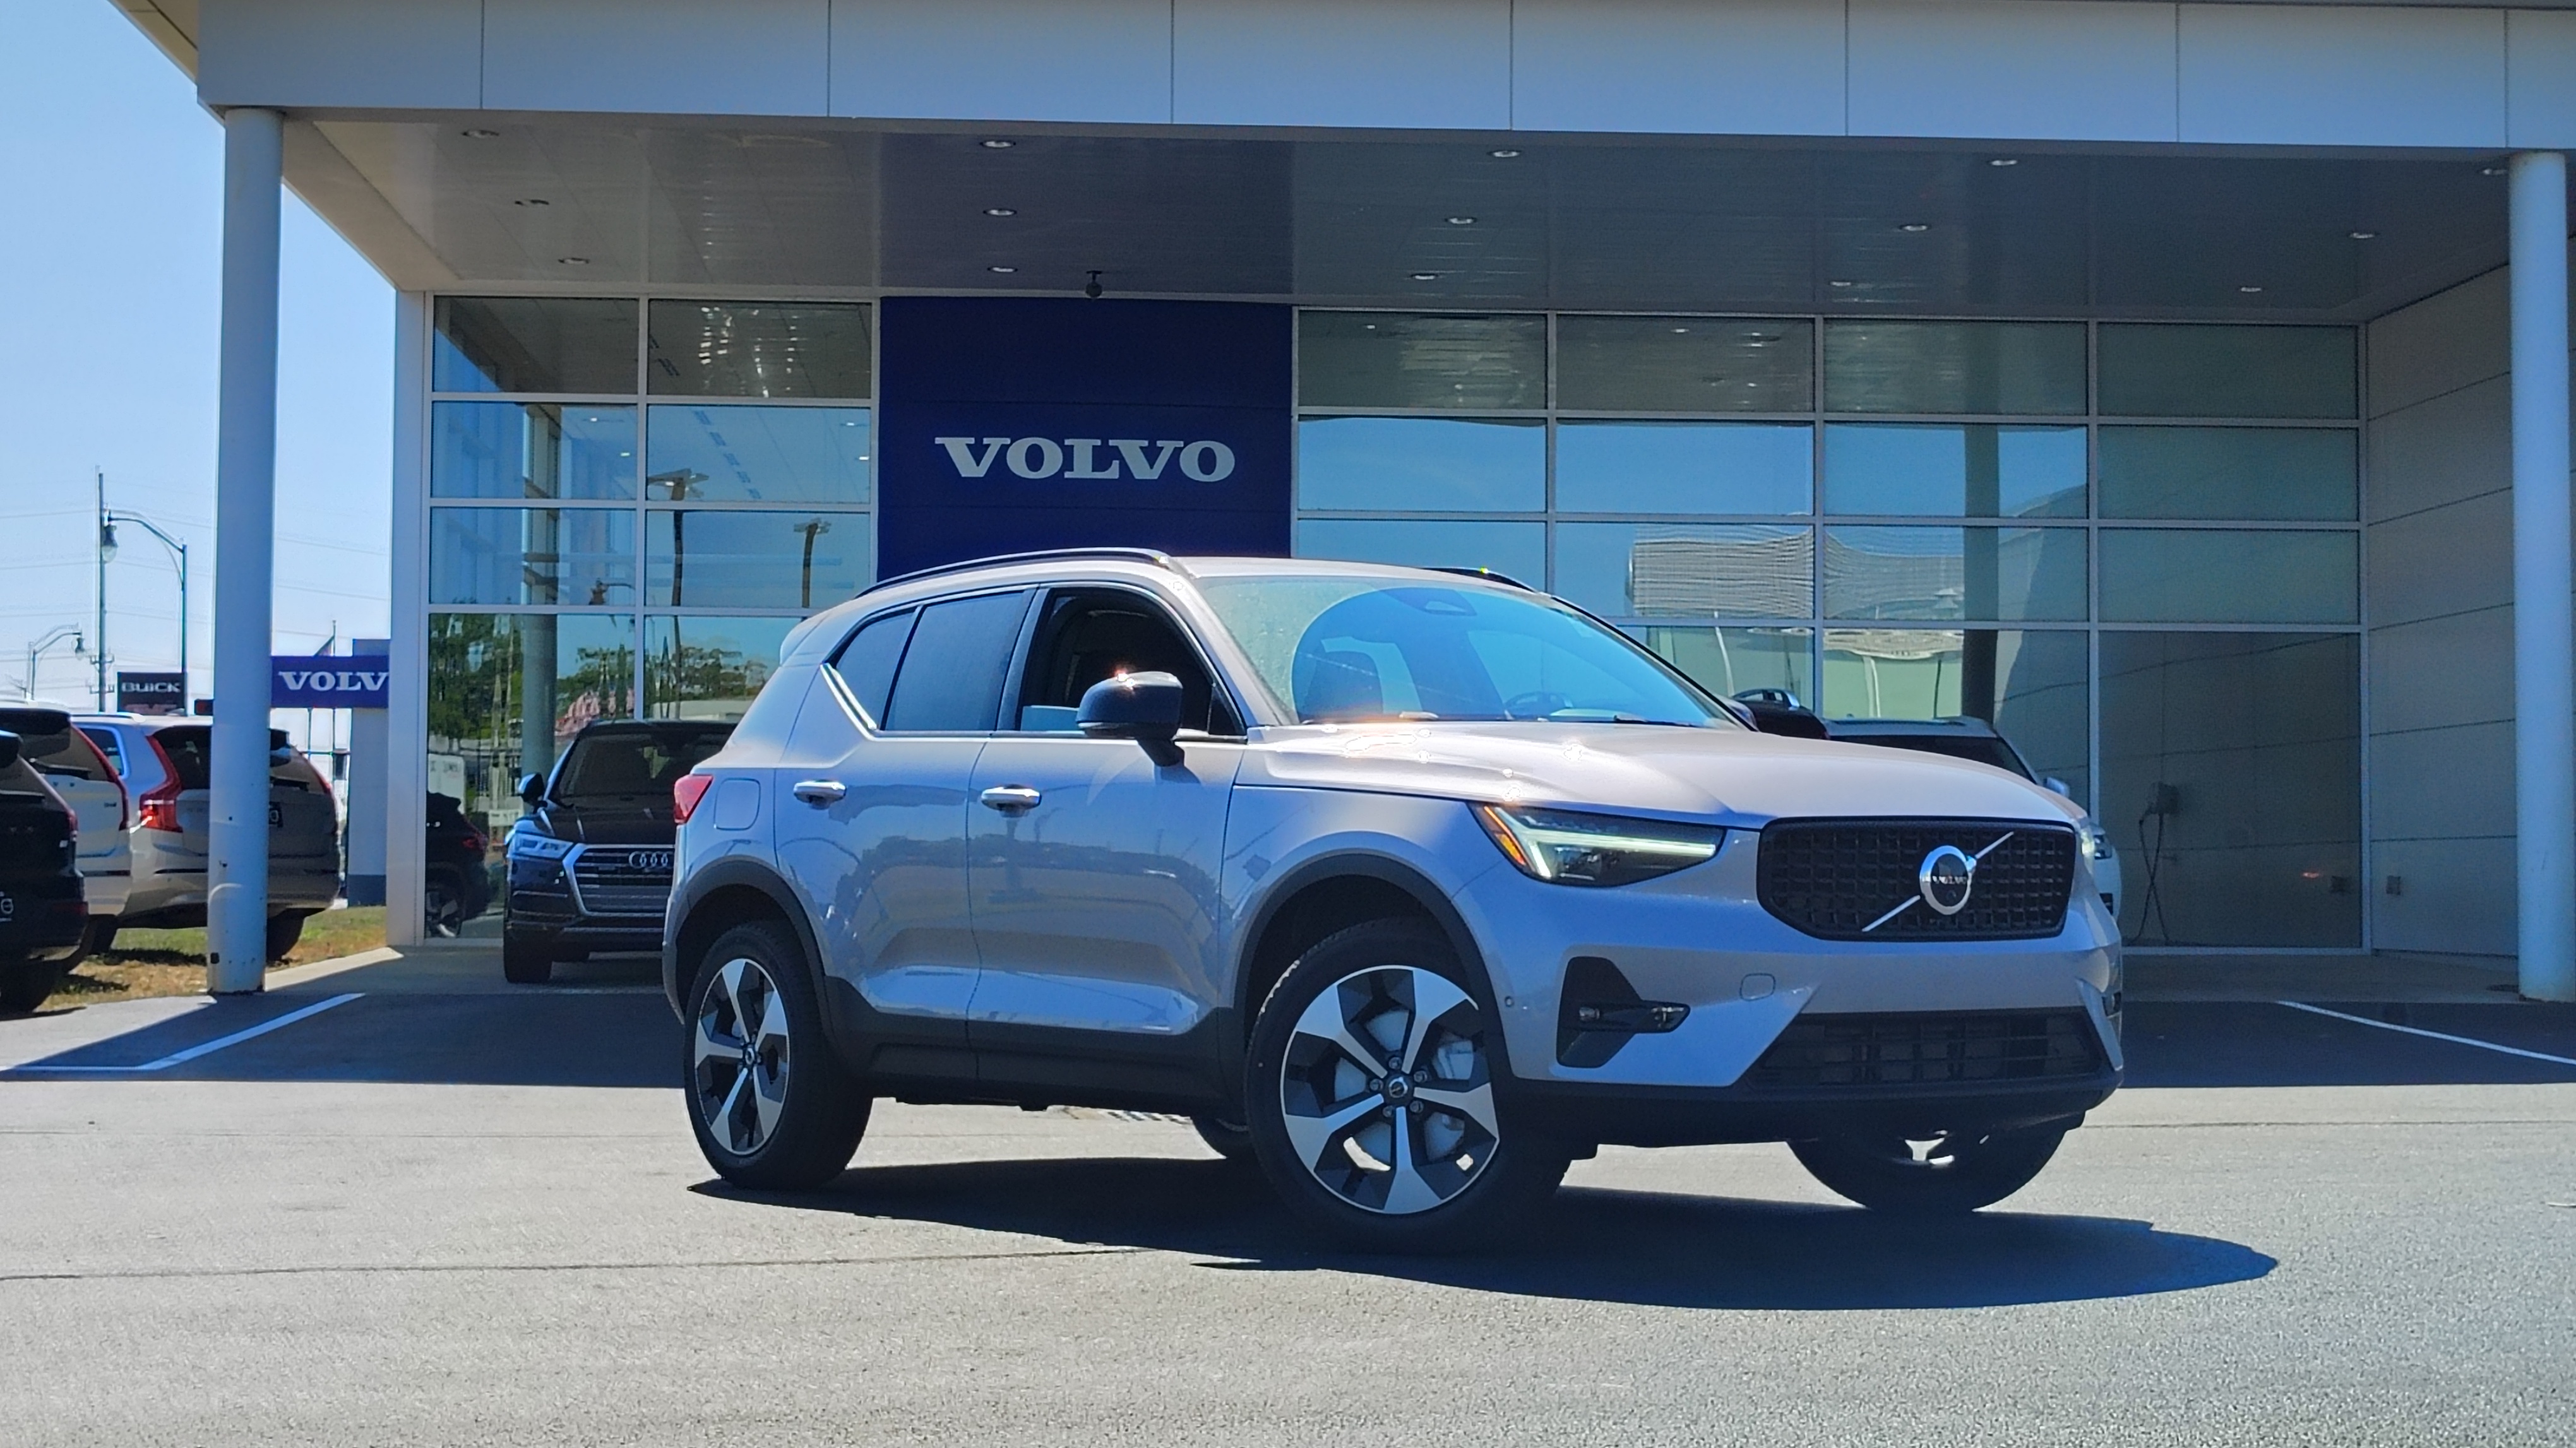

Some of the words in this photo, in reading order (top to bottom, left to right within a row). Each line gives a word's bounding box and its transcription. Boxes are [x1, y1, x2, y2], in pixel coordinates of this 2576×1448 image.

[934, 437, 1236, 482] VOLVO
[121, 682, 181, 693] BUICK
[278, 671, 389, 691] VOLV
